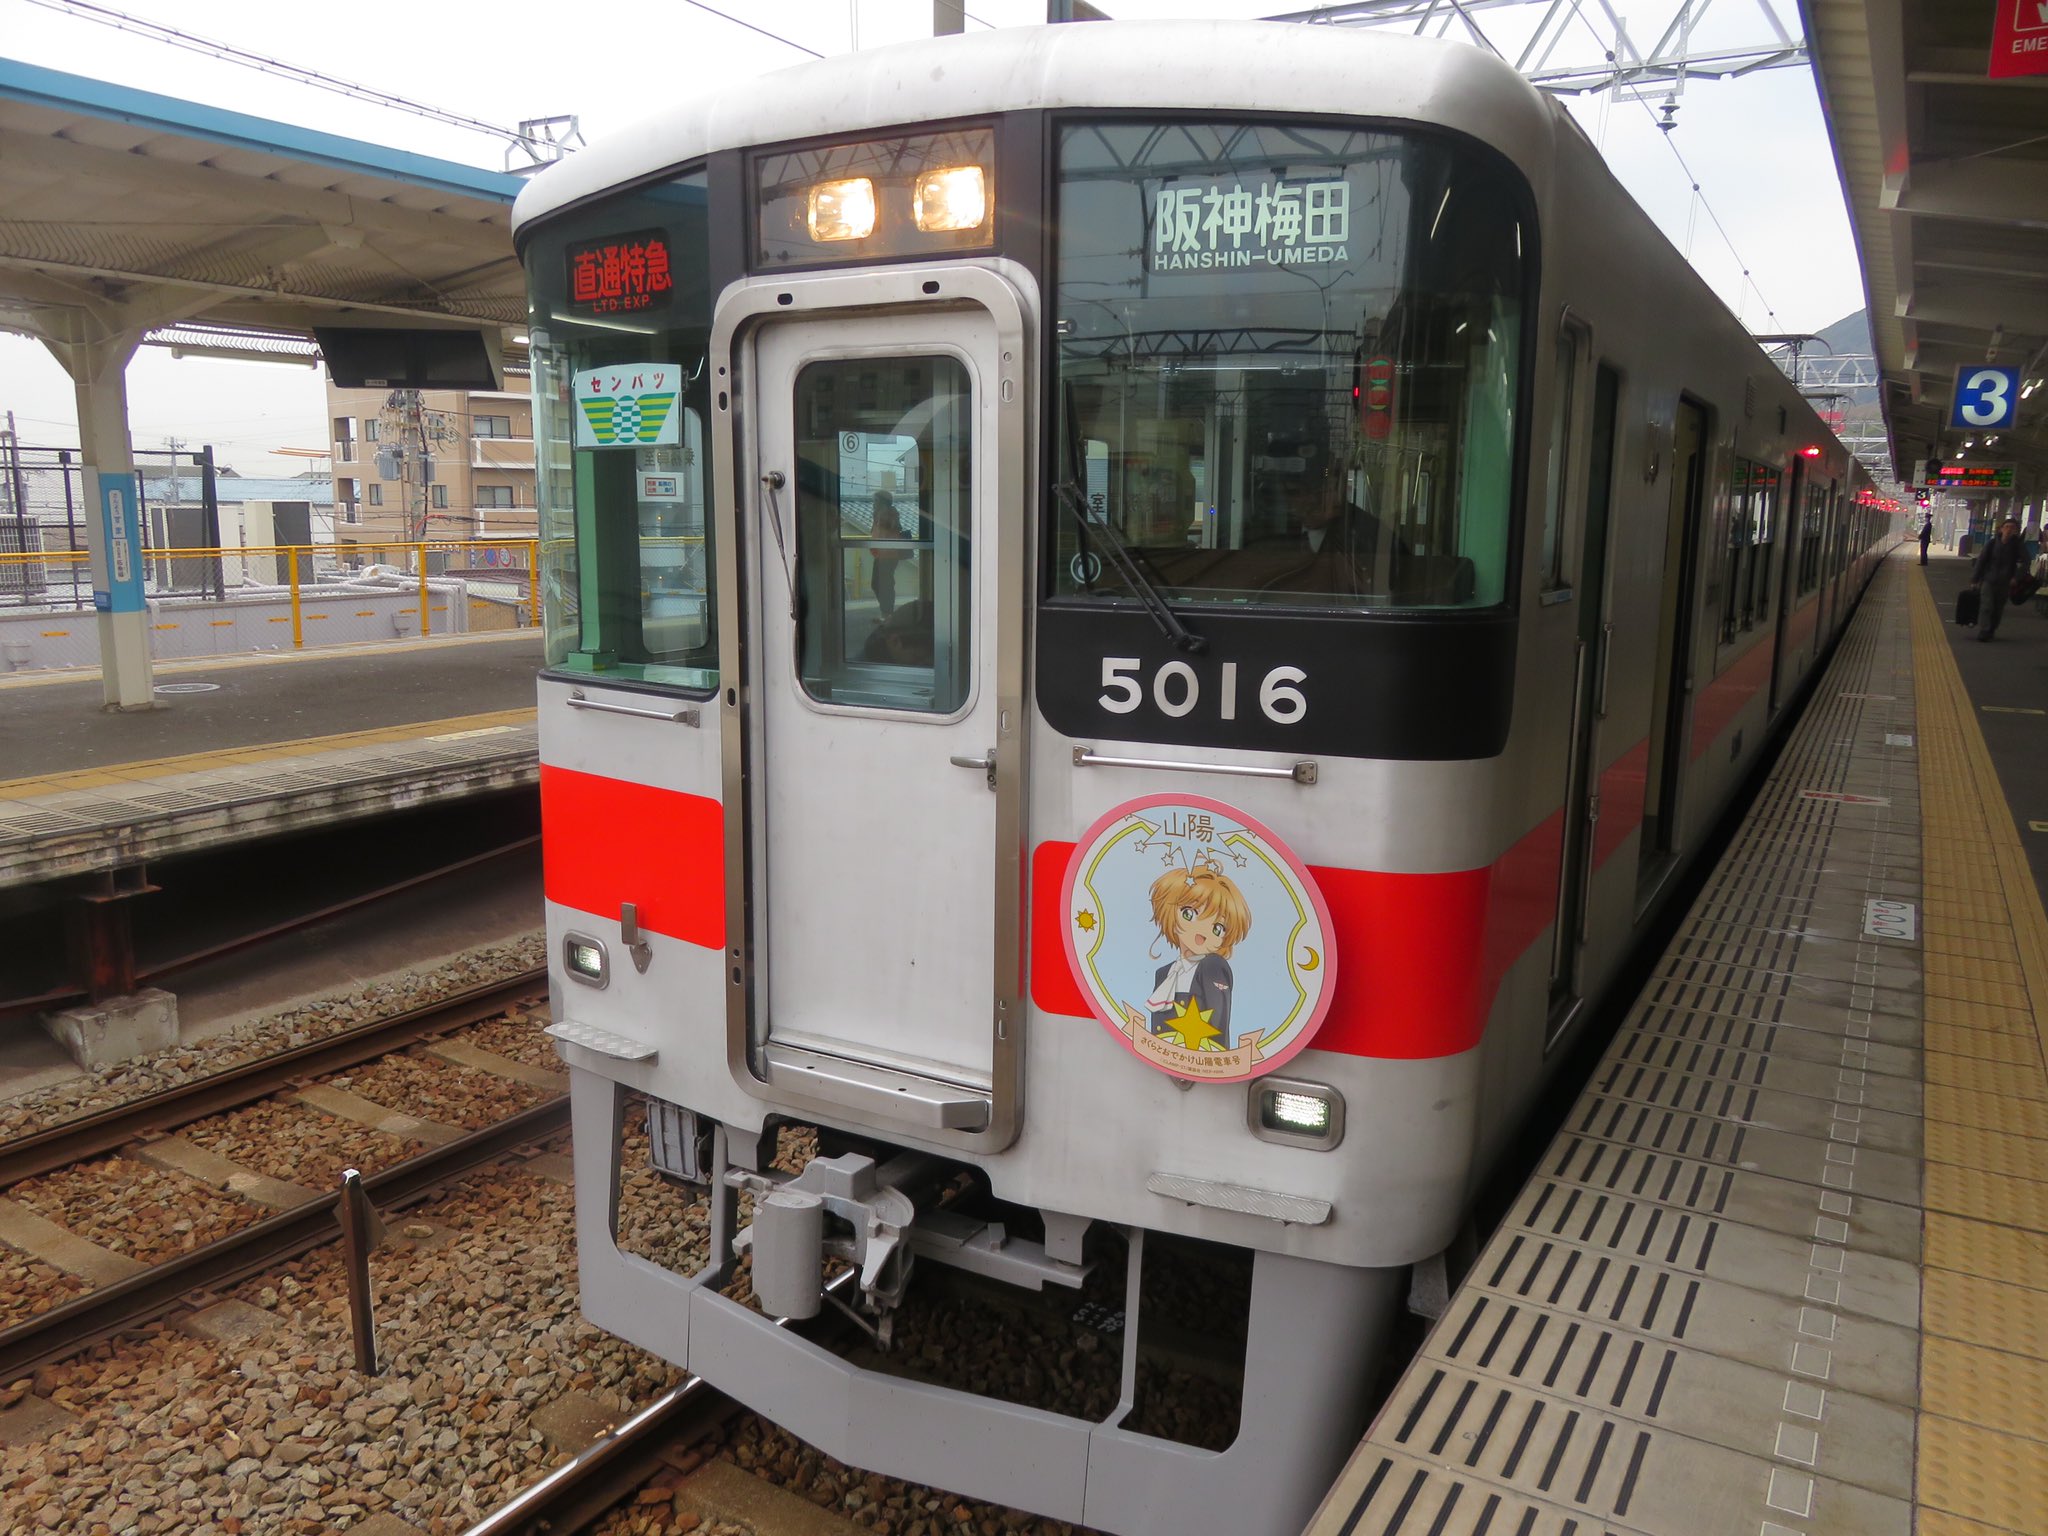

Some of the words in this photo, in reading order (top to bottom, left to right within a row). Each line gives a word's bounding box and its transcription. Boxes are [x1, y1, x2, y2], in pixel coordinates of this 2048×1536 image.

[1156, 181, 1349, 252] 阪神梅田
[574, 239, 672, 301] 直通特急
[1154, 246, 1349, 270] HANSHIN-UMEDA
[591, 373, 664, 393] センバツ
[1961, 370, 2009, 426] 3
[1098, 657, 1307, 725] 5016
[1164, 811, 1215, 843] 山陽
[1140, 1037, 1240, 1067] さくらとおでかけ山陽電車号
